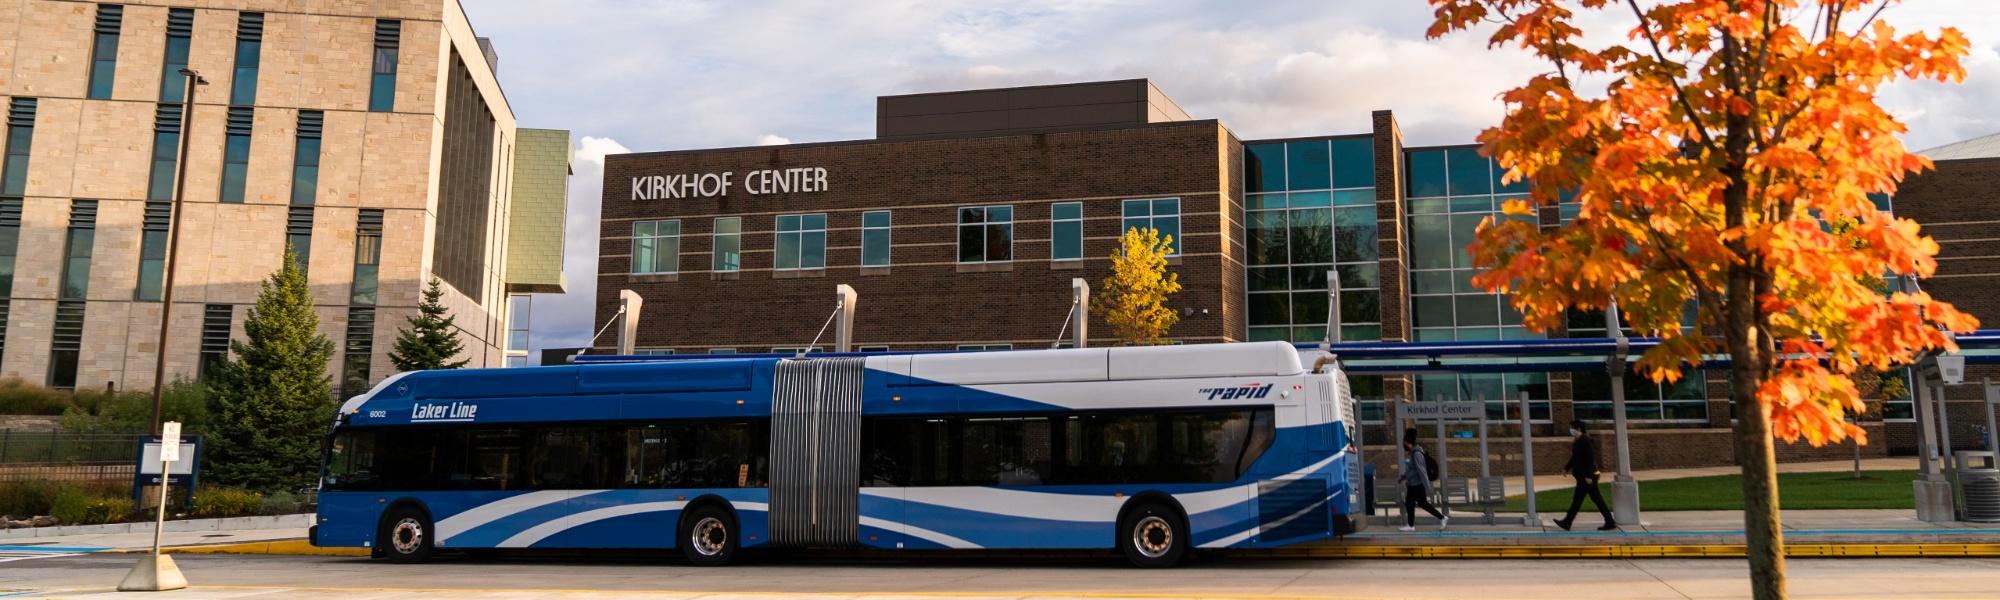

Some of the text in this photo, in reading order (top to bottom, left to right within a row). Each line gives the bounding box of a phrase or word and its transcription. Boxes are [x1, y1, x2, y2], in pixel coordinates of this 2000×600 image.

[631, 167, 828, 200] KIRKHOF CENTER
[1207, 383, 1274, 400] rapid
[369, 410, 387, 418] 6002
[411, 401, 477, 419] Laker Line
[1407, 404, 1472, 414] Kirkhof Center
